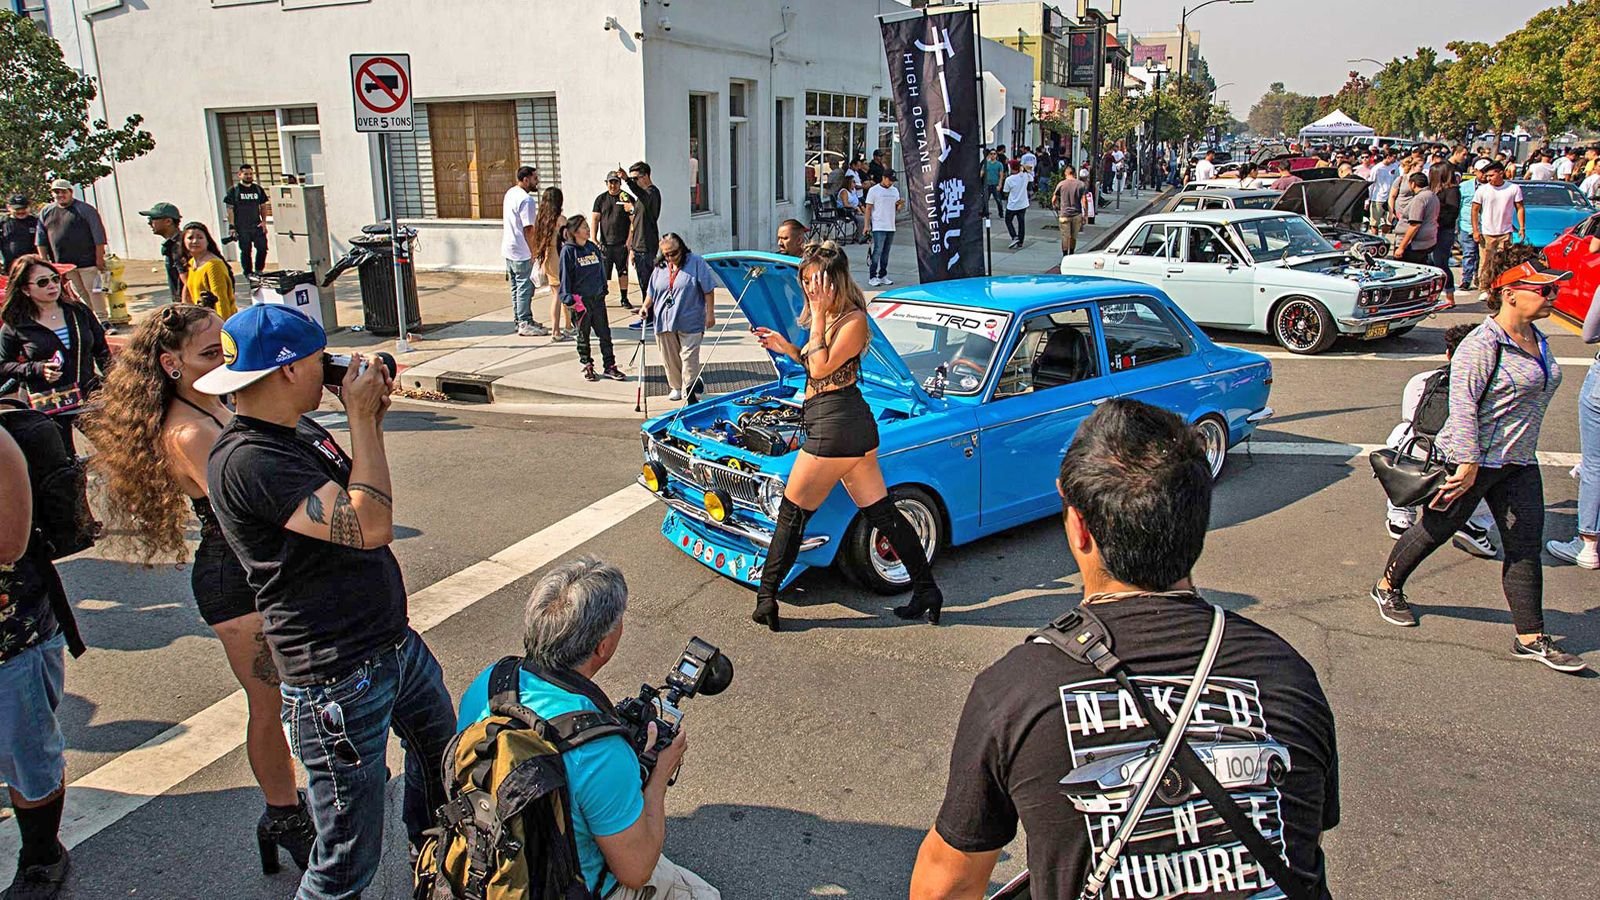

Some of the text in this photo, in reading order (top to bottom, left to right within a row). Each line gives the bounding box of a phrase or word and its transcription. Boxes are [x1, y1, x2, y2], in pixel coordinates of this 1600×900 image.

[357, 117, 411, 128] OVER 5 TONS
[903, 53, 941, 254] HIGH OCTANE TUNERS
[936, 312, 980, 330] TRD
[276, 352, 297, 362] adidas
[1076, 686, 1252, 736] NAKED
[1225, 755, 1255, 779] 100
